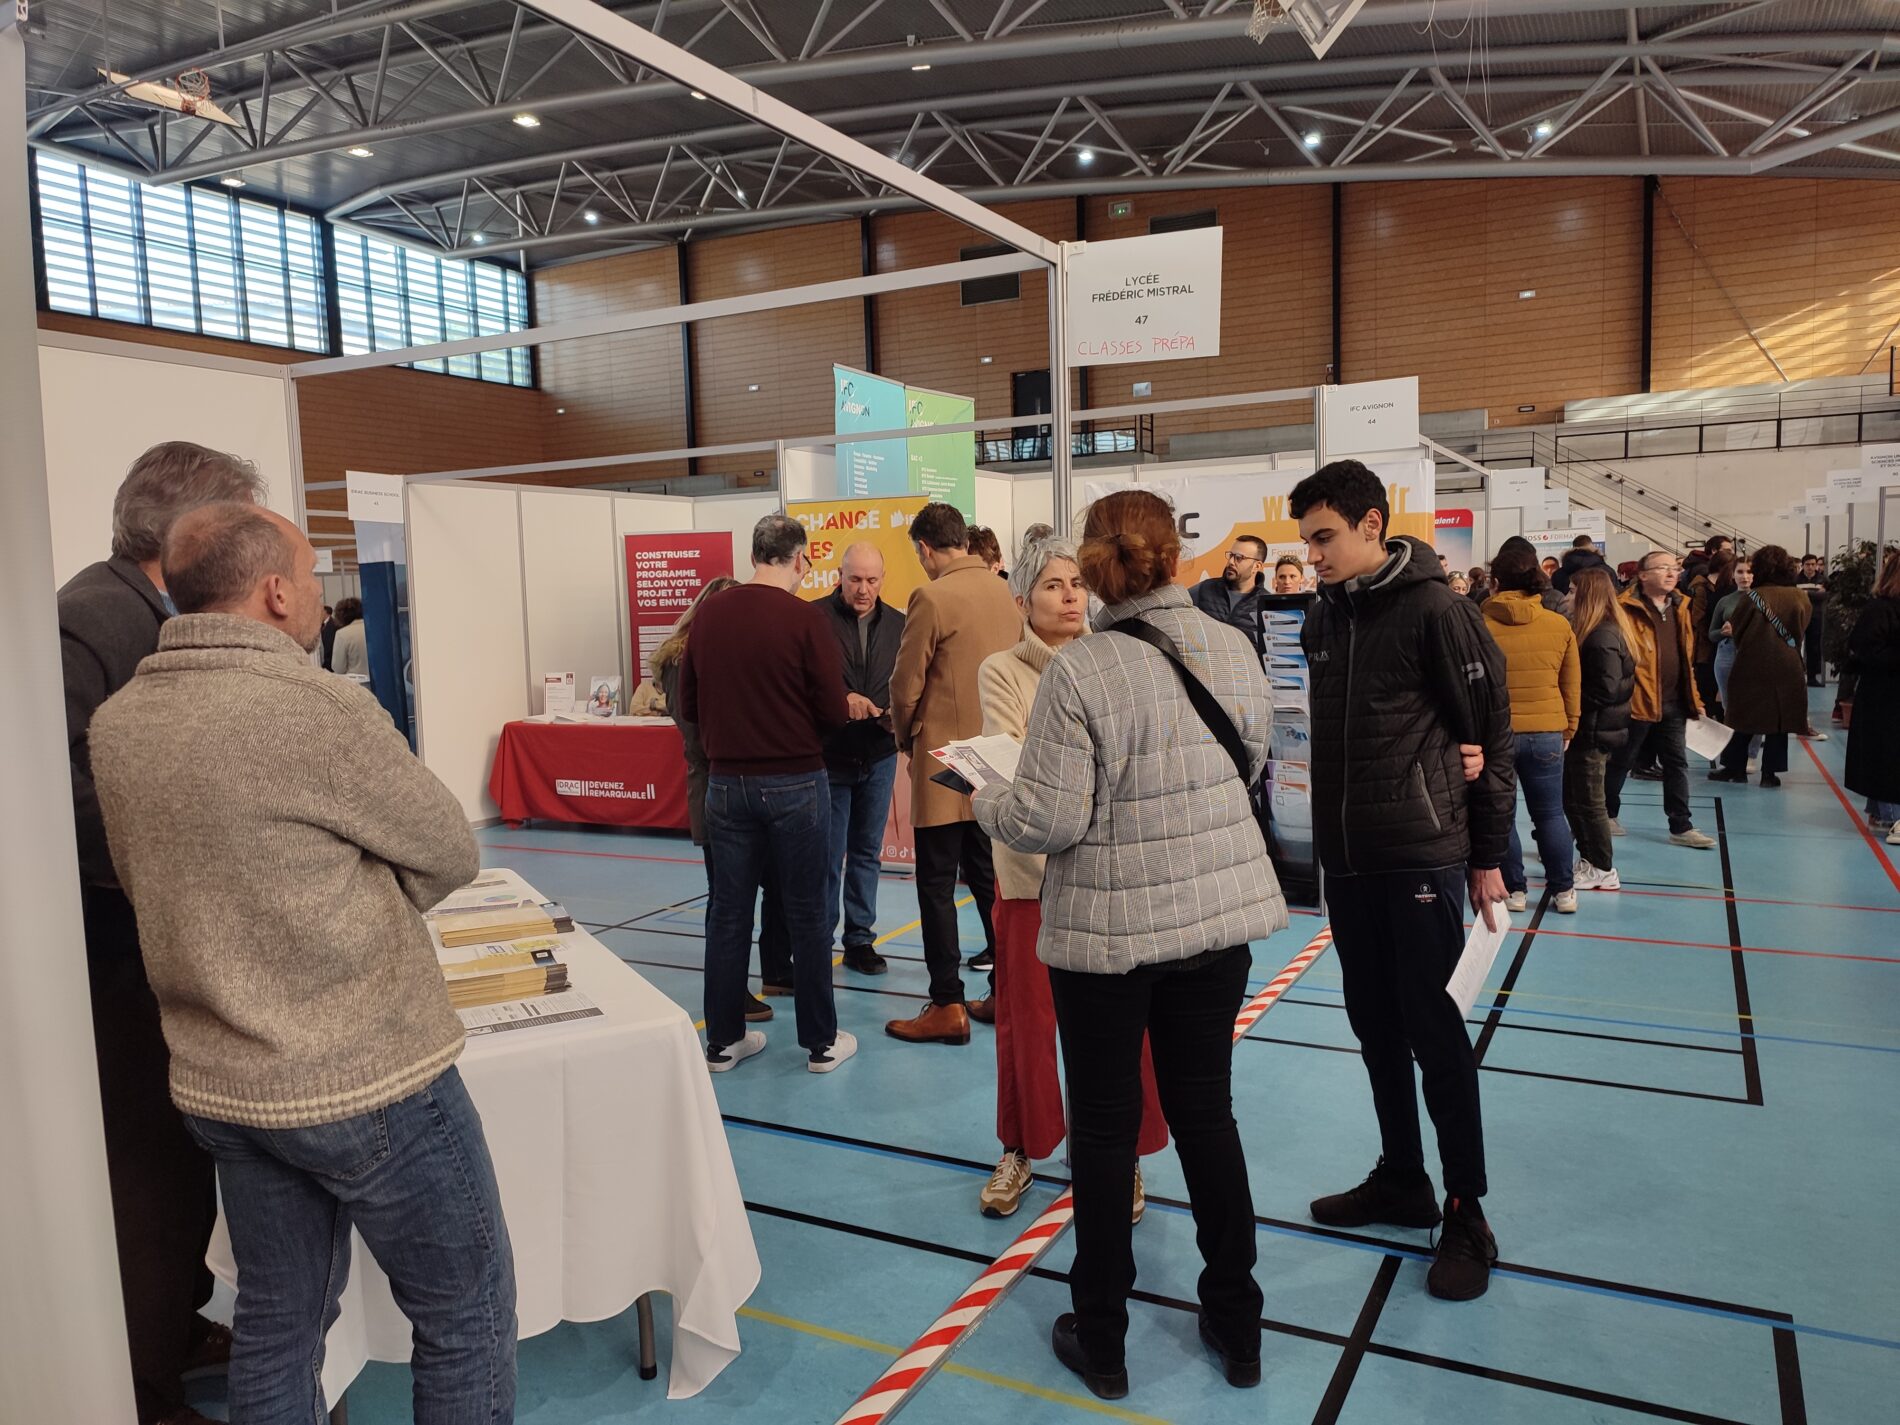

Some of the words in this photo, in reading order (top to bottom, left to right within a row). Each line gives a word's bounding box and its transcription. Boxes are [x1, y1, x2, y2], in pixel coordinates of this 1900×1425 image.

[1125, 272, 1160, 287] LYCÉE
[1091, 288, 1144, 303] FRÉDÉRIC
[1147, 284, 1194, 298] MISTRAL
[1134, 315, 1149, 325] 47
[1077, 340, 1143, 356] CLASSES
[1151, 331, 1195, 353] PRÉPA
[1349, 405, 1361, 413] IFC
[1361, 401, 1394, 411] AVIGNON
[796, 509, 880, 532] CHANGE
[1434, 516, 1455, 525] alent
[635, 550, 701, 559] CONSTRUISEZ
[807, 540, 834, 560] ES
[1271, 547, 1307, 558] Format
[635, 560, 668, 569] VOTRE
[636, 569, 696, 579] PROGRAMME
[800, 569, 840, 589] CHO
[636, 579, 668, 588] SELON
[669, 578, 702, 587] VOTRE
[637, 589, 673, 598] PROJET
[675, 588, 687, 596] ET
[637, 599, 657, 607] VOS
[659, 598, 693, 607] ENVIES
[589, 781, 624, 790] DEVENEZ
[589, 789, 647, 800] REMARQUABLE
